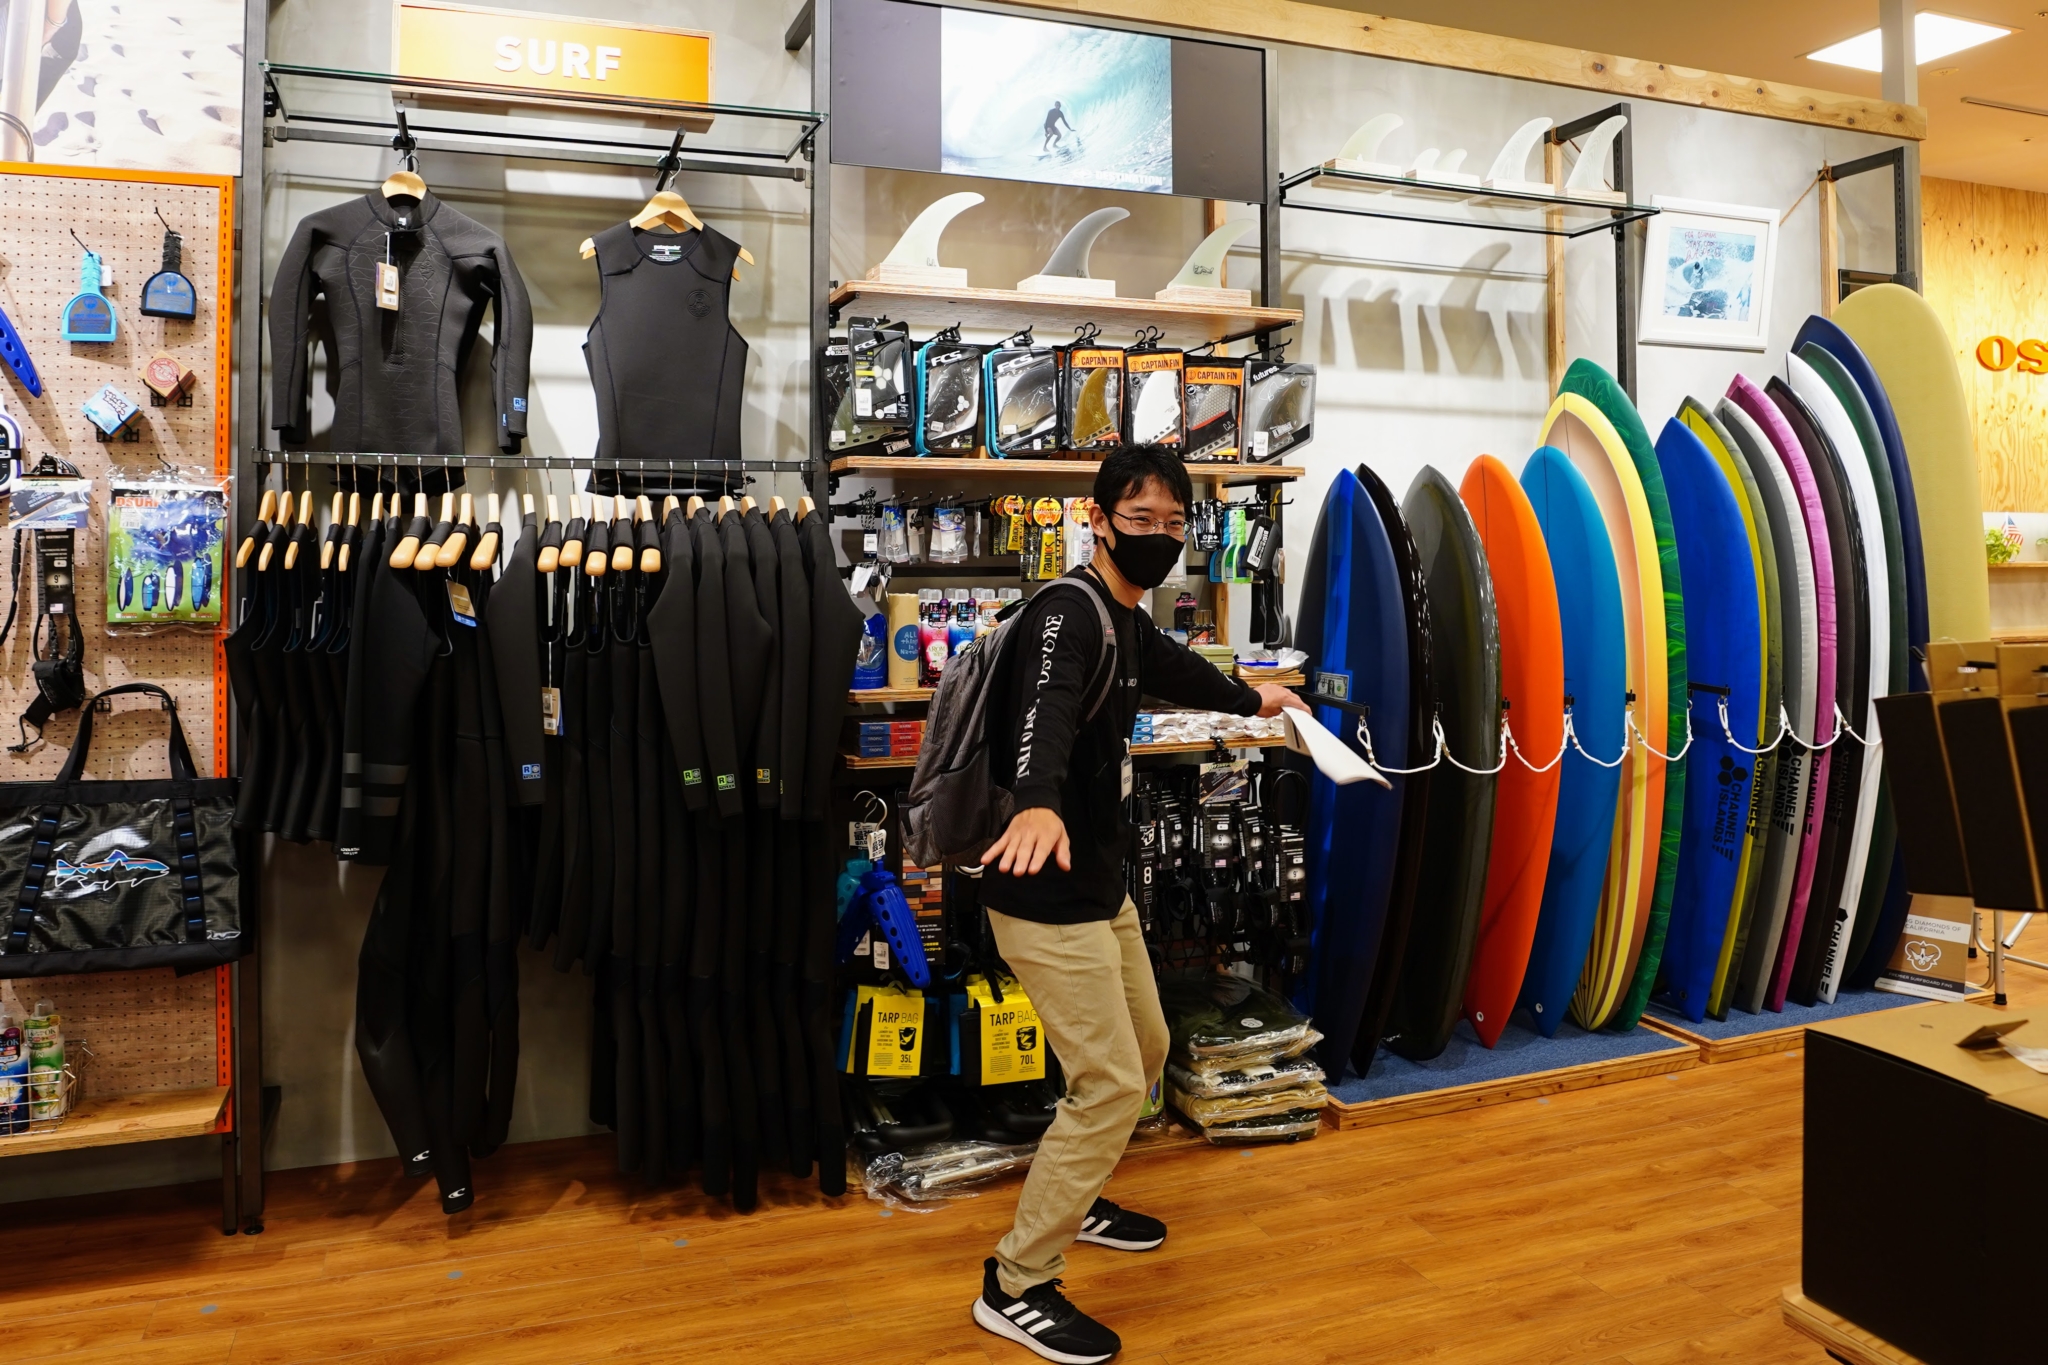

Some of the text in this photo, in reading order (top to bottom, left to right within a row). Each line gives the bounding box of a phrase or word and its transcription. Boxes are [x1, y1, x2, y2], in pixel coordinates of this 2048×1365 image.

[494, 36, 621, 81] SURF
[931, 350, 962, 366] FCS
[997, 354, 1034, 373] FCS
[1081, 356, 1119, 366] CAPTAIN FIN
[1141, 358, 1179, 370] CAPTAIN FIN
[1197, 370, 1237, 380] CAPTAIN FIN
[1012, 519, 1020, 543] Solarez
[1044, 542, 1055, 572] Solarez
[1773, 763, 1789, 817] ISLANDS
[1783, 757, 1802, 821] CHANNEL
[1713, 788, 1730, 843] ISLANDS
[1723, 783, 1742, 846] CHANNEL
[1144, 866, 1152, 884] 8
[1905, 923, 1945, 935] CALIFORNIA
[1914, 919, 1950, 930] DIAMONDS
[1821, 922, 1842, 980] CHANNEL
[1910, 976, 1941, 986] SURFBOARD
[877, 1012, 919, 1024] TARP BAG
[990, 1009, 1037, 1026] TARP BAG
[900, 1054, 912, 1063] 35L
[1020, 1054, 1035, 1065] 70L
